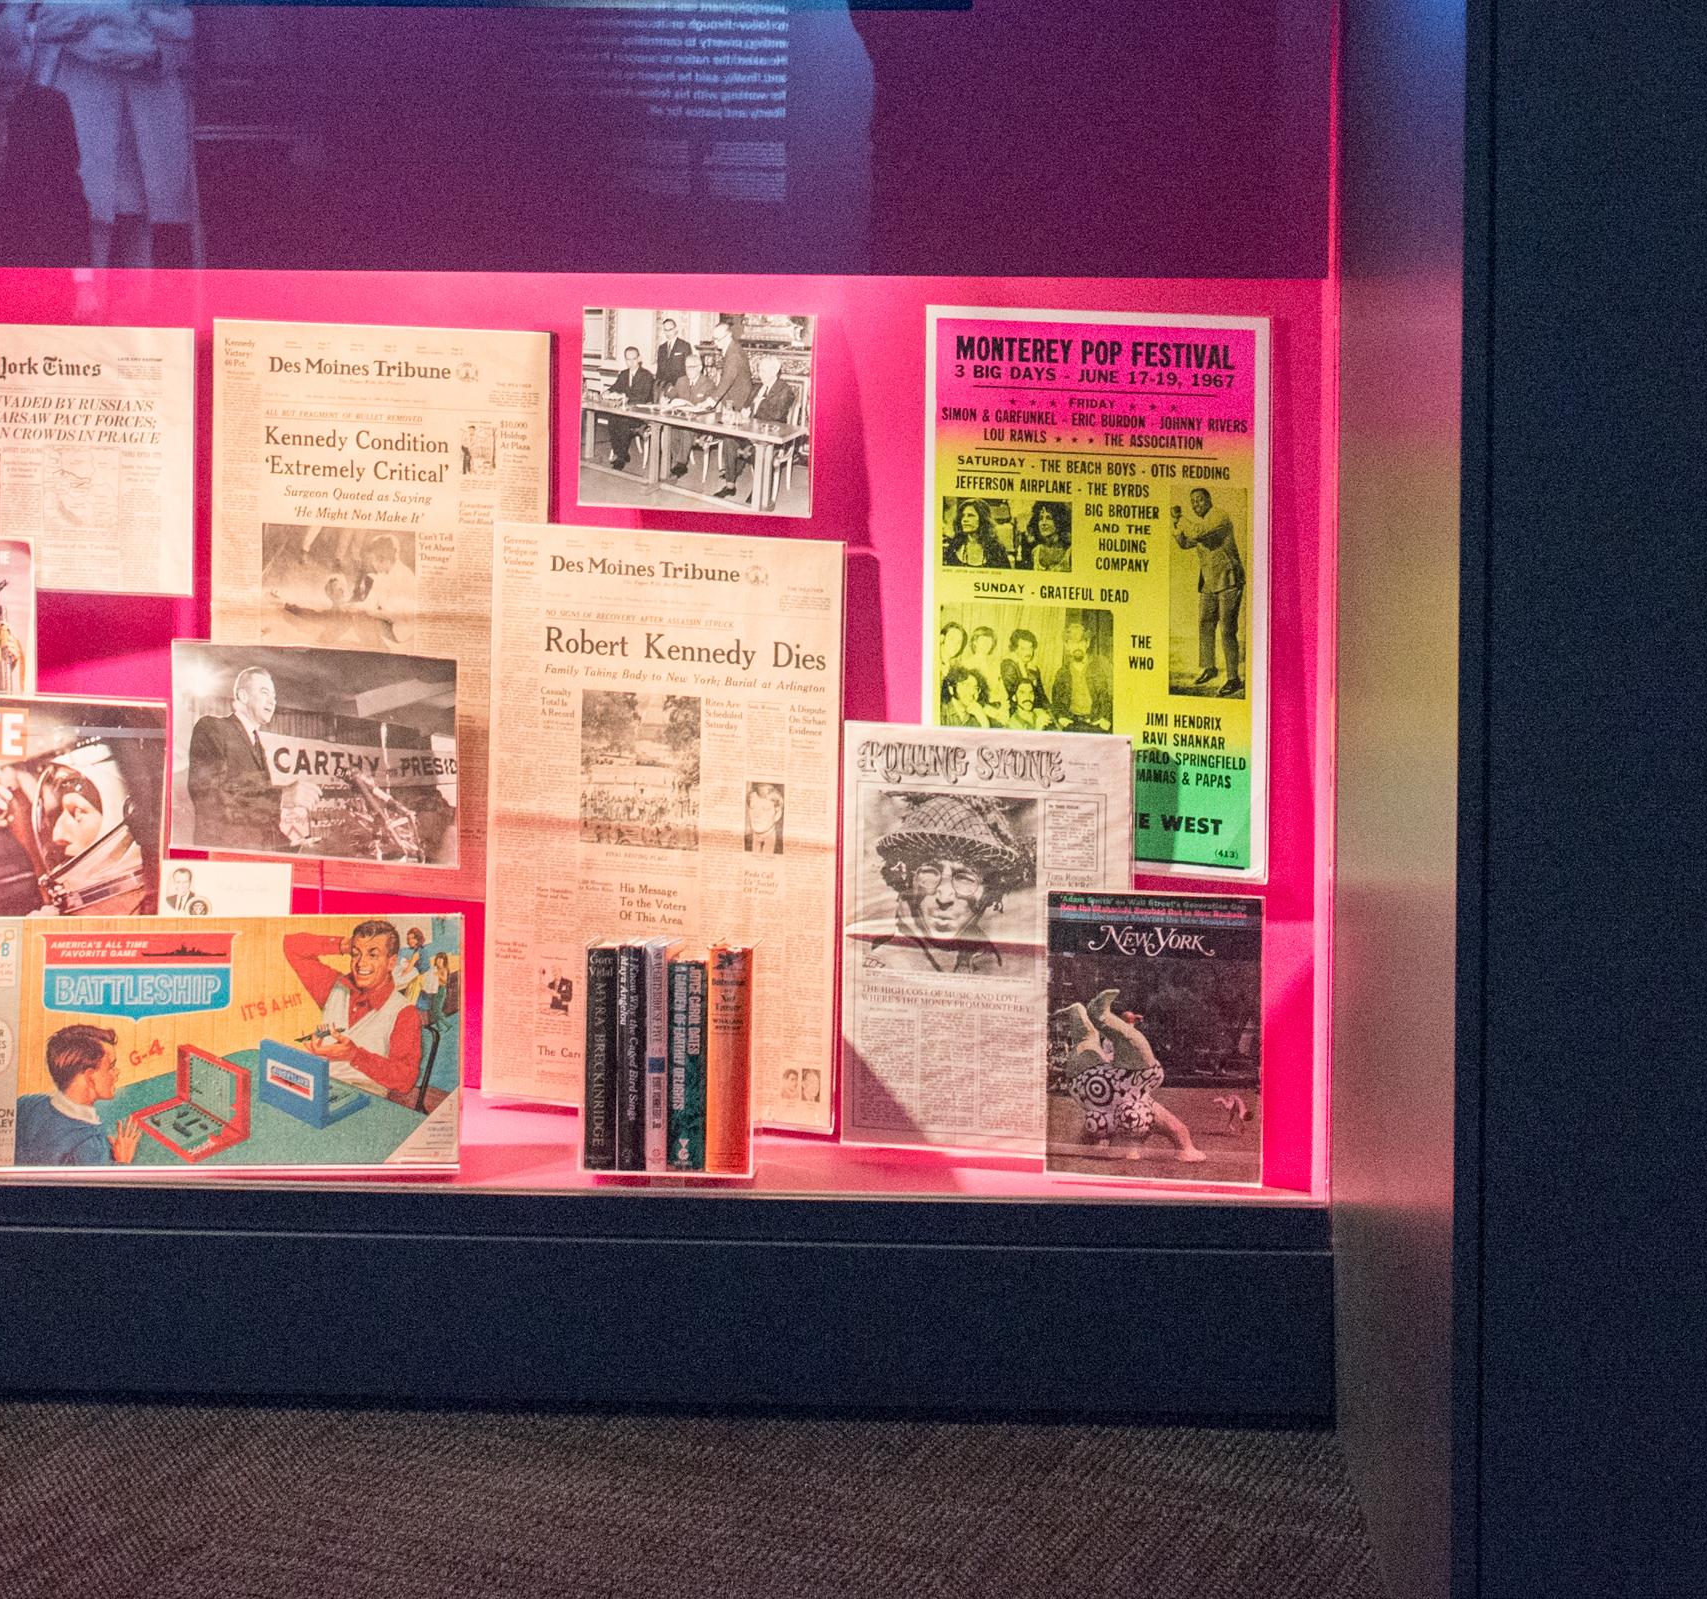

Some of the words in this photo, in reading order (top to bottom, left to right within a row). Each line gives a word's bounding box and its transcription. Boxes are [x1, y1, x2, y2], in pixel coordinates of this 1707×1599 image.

[956, 336, 1073, 364] MONTEREY
[1082, 341, 1122, 365] POP
[1132, 342, 1235, 369] FESTIVAL
[44, 357, 101, 377] Times
[269, 356, 301, 373] Des
[305, 358, 369, 376] Moines
[374, 360, 451, 379] Tribune
[955, 365, 965, 378] 3
[973, 366, 1002, 379] BIG
[1010, 367, 1056, 381] DAYS
[1078, 369, 1119, 383] JUNE
[1129, 371, 1182, 387] 17-19,
[1192, 374, 1235, 388] 1967
[55, 397, 76, 410] BY
[79, 397, 154, 412] RUSSIANS
[54, 413, 92, 426] PACT
[95, 415, 158, 429] FORCES;
[12, 427, 74, 441] CROWDS
[76, 430, 95, 442] IN
[99, 430, 160, 444] PRAGUE
[265, 426, 348, 451] Kennedy
[356, 431, 449, 453] Condition
[550, 555, 584, 572] Des
[588, 557, 655, 577] Moines
[660, 560, 740, 582] Tribune
[544, 626, 628, 657] Robert
[644, 632, 756, 670] Kennedy
[772, 641, 827, 670] Dies
[544, 664, 578, 678] Family
[583, 666, 618, 680] Taking
[622, 668, 648, 683] Body
[652, 672, 663, 680] to
[667, 673, 688, 682] New
[725, 677, 758, 688] Burial
[762, 681, 772, 690] at
[776, 682, 826, 694] Arlington
[51, 941, 102, 950] AMERICA'S
[104, 941, 123, 949] ALL
[126, 941, 148, 949] TIME
[61, 949, 106, 958] FAVORITE
[109, 950, 136, 958] GAME
[54, 971, 223, 1007] BATTLESHIP
